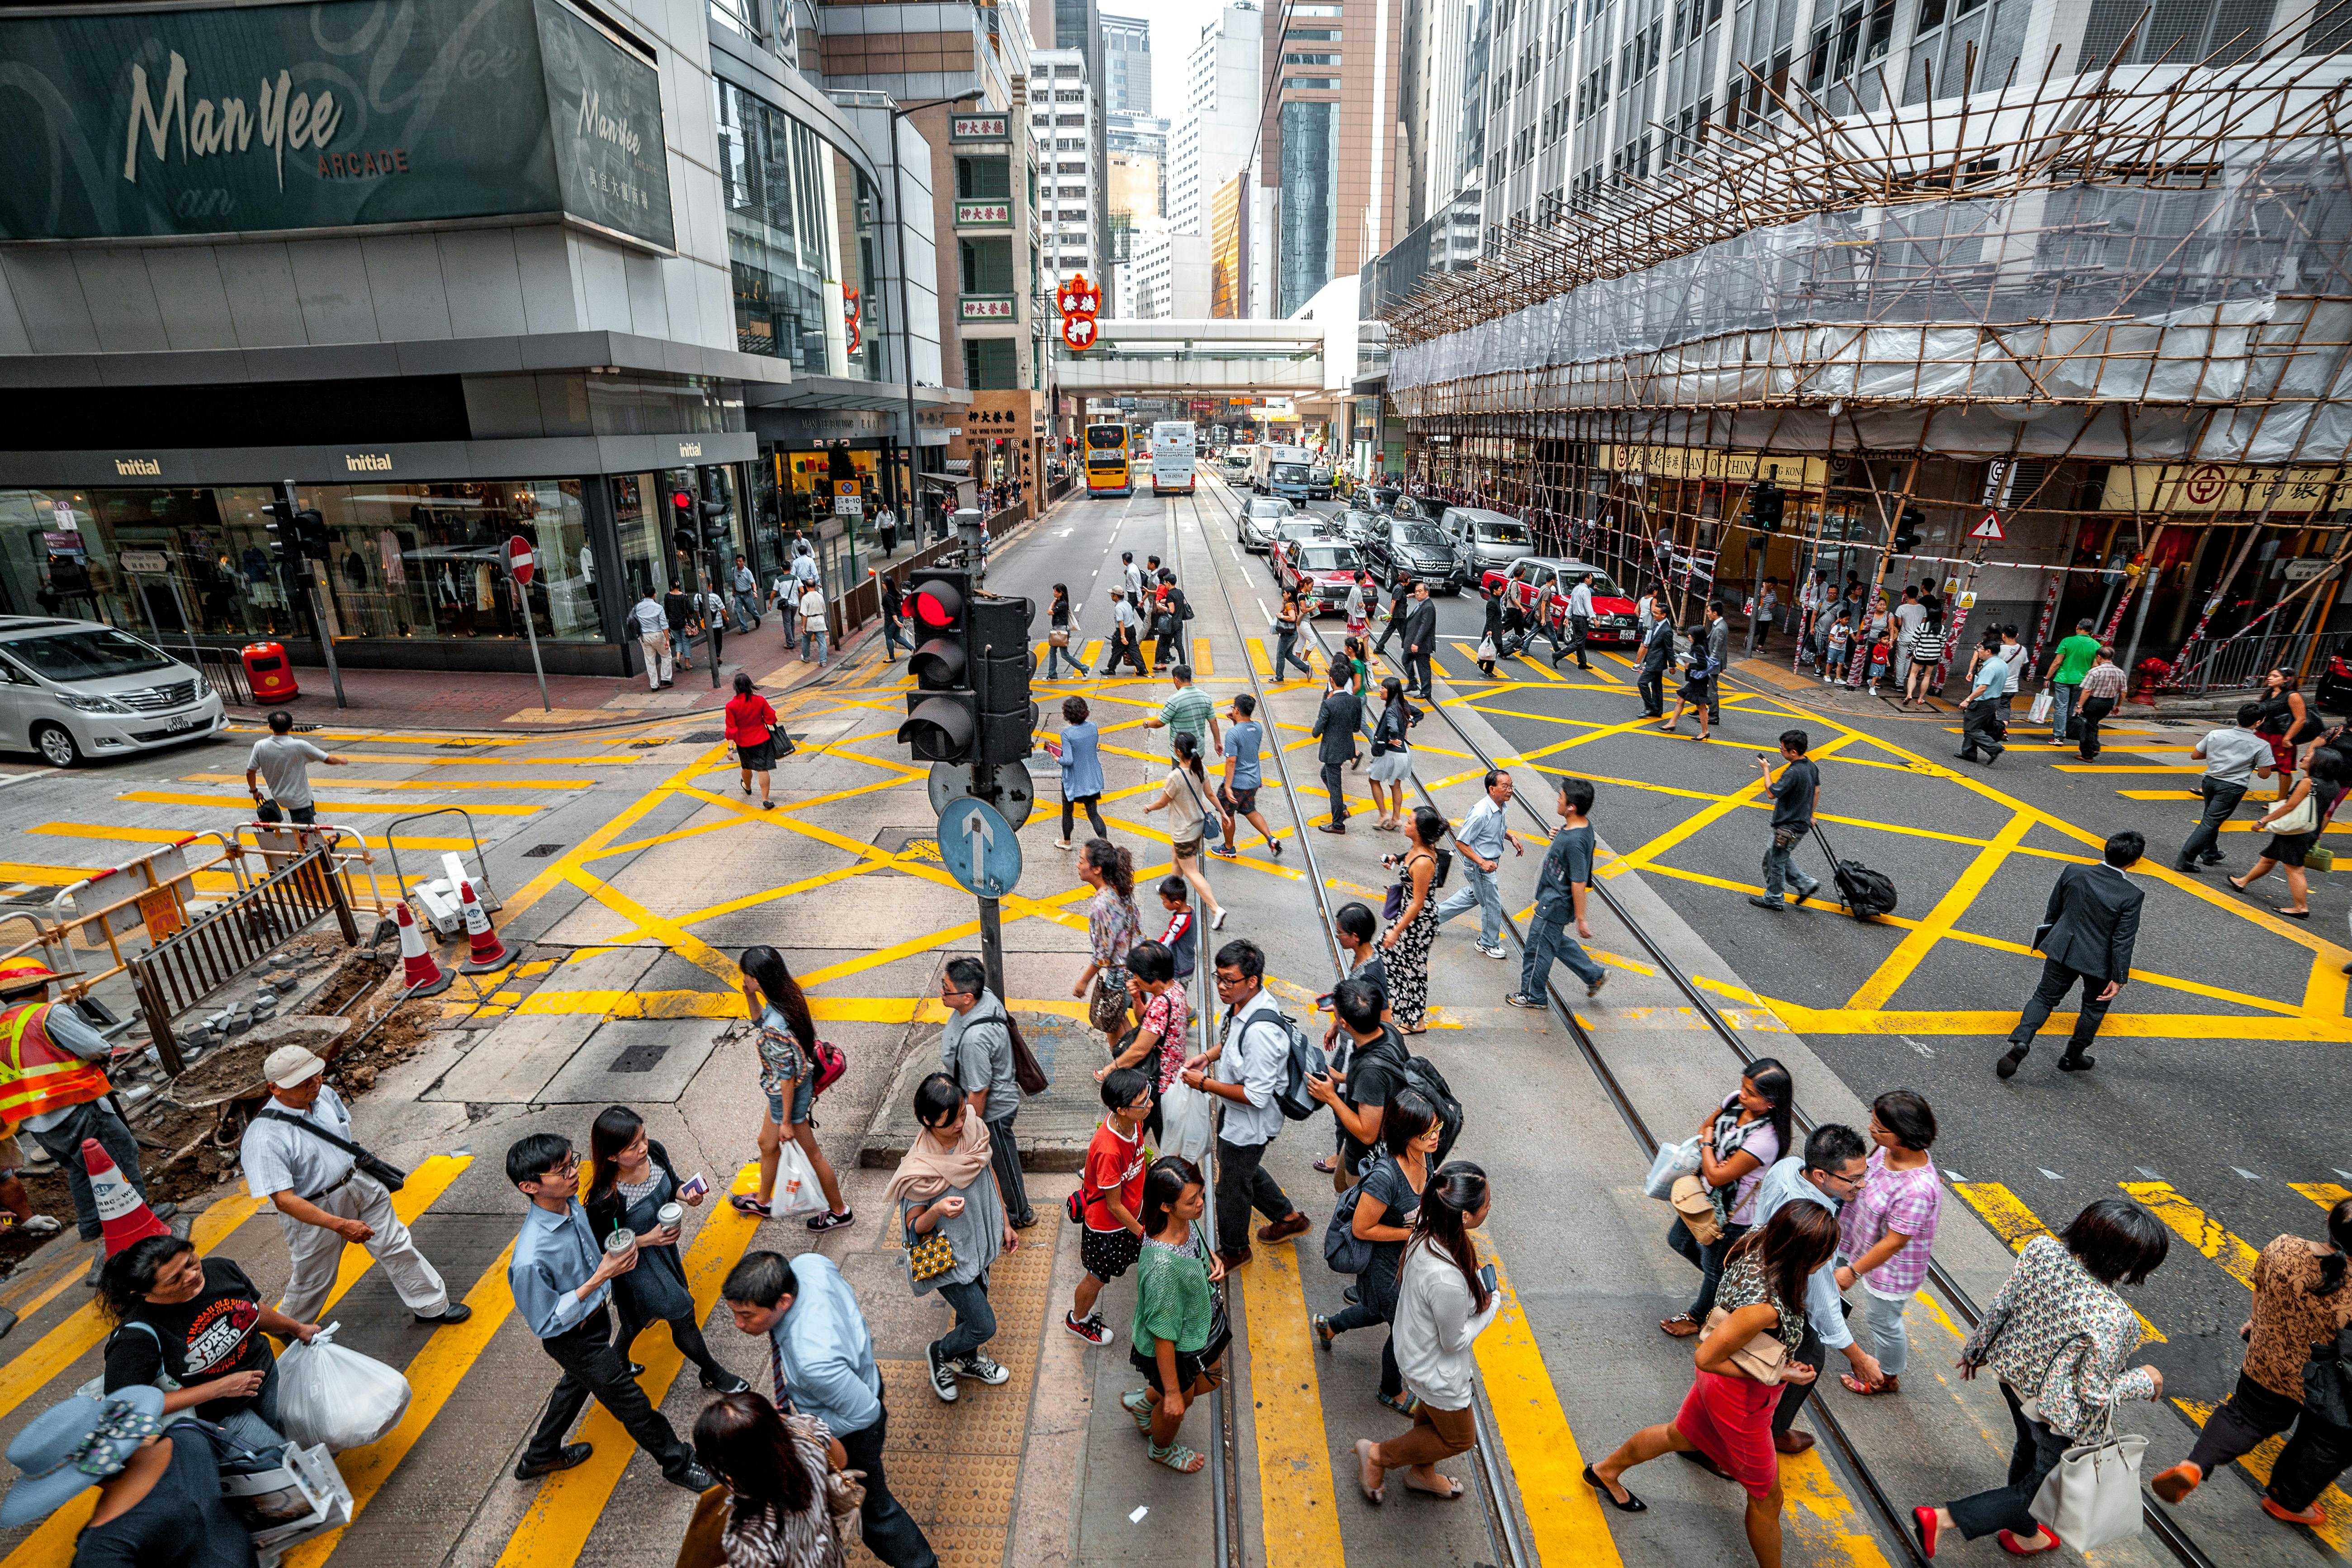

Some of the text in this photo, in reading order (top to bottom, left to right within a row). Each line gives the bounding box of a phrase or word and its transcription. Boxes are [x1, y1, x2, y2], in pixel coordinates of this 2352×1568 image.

[123, 49, 343, 194] Man Yee
[577, 86, 641, 166] Man Yee
[317, 149, 408, 178] ARCADE
[634, 158, 658, 177] ARCADE
[1068, 317, 1091, 344] 押
[801, 419, 854, 429] MAN YEE BUILDING
[345, 453, 392, 471] initial
[679, 442, 702, 458] initial
[115, 459, 161, 475] initial
[189, 1305, 215, 1335] HAWAII
[214, 1298, 230, 1309] OLD
[184, 1323, 230, 1372] SURF
[188, 1328, 213, 1350] SOUTHERN
[204, 1327, 241, 1365] BOARD
